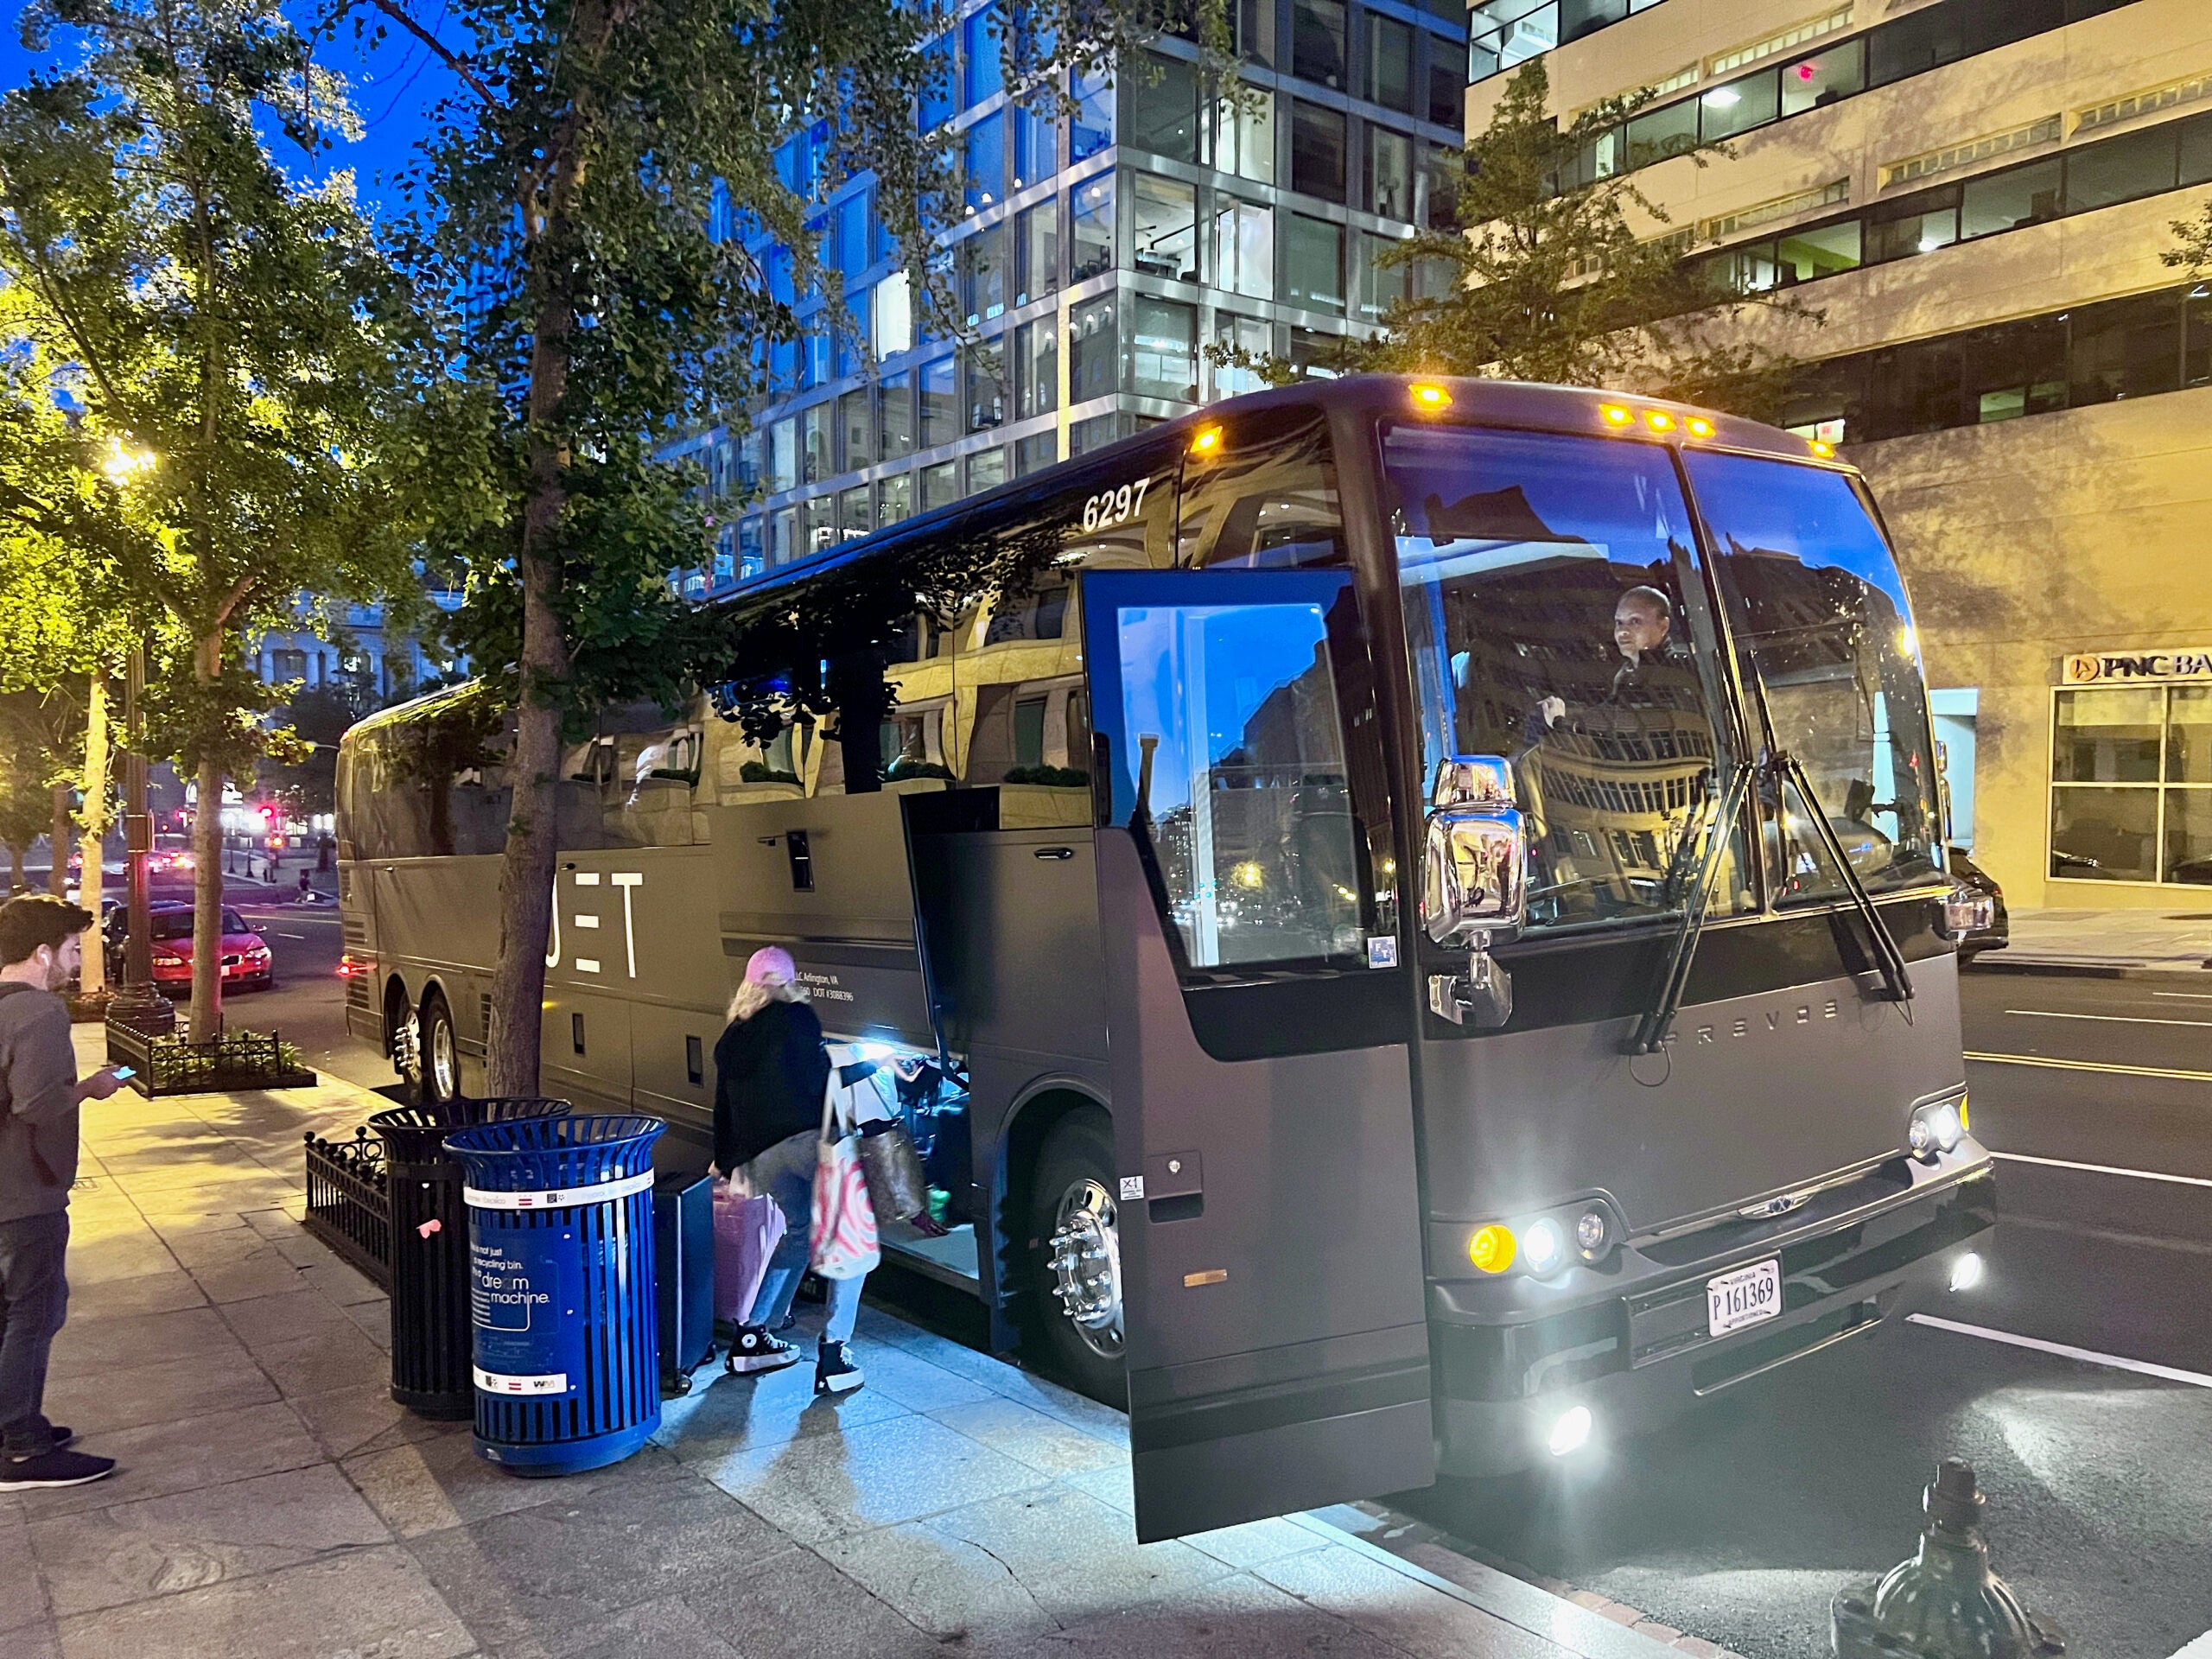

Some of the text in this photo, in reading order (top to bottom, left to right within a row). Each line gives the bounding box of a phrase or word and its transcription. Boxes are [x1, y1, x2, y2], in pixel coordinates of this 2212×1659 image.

[1083, 477, 1150, 532] 6297
[2101, 656, 2169, 677] PNC
[545, 873, 643, 978] JET
[804, 972, 830, 985] Arlington,
[830, 976, 839, 985] VA
[812, 987, 825, 998] DOT
[1664, 999, 1862, 1045] PREVOS
[489, 1247, 502, 1257] just
[506, 1260, 524, 1270] bin.
[490, 1291, 550, 1305] machine.
[1713, 1277, 1774, 1320] P 161369
